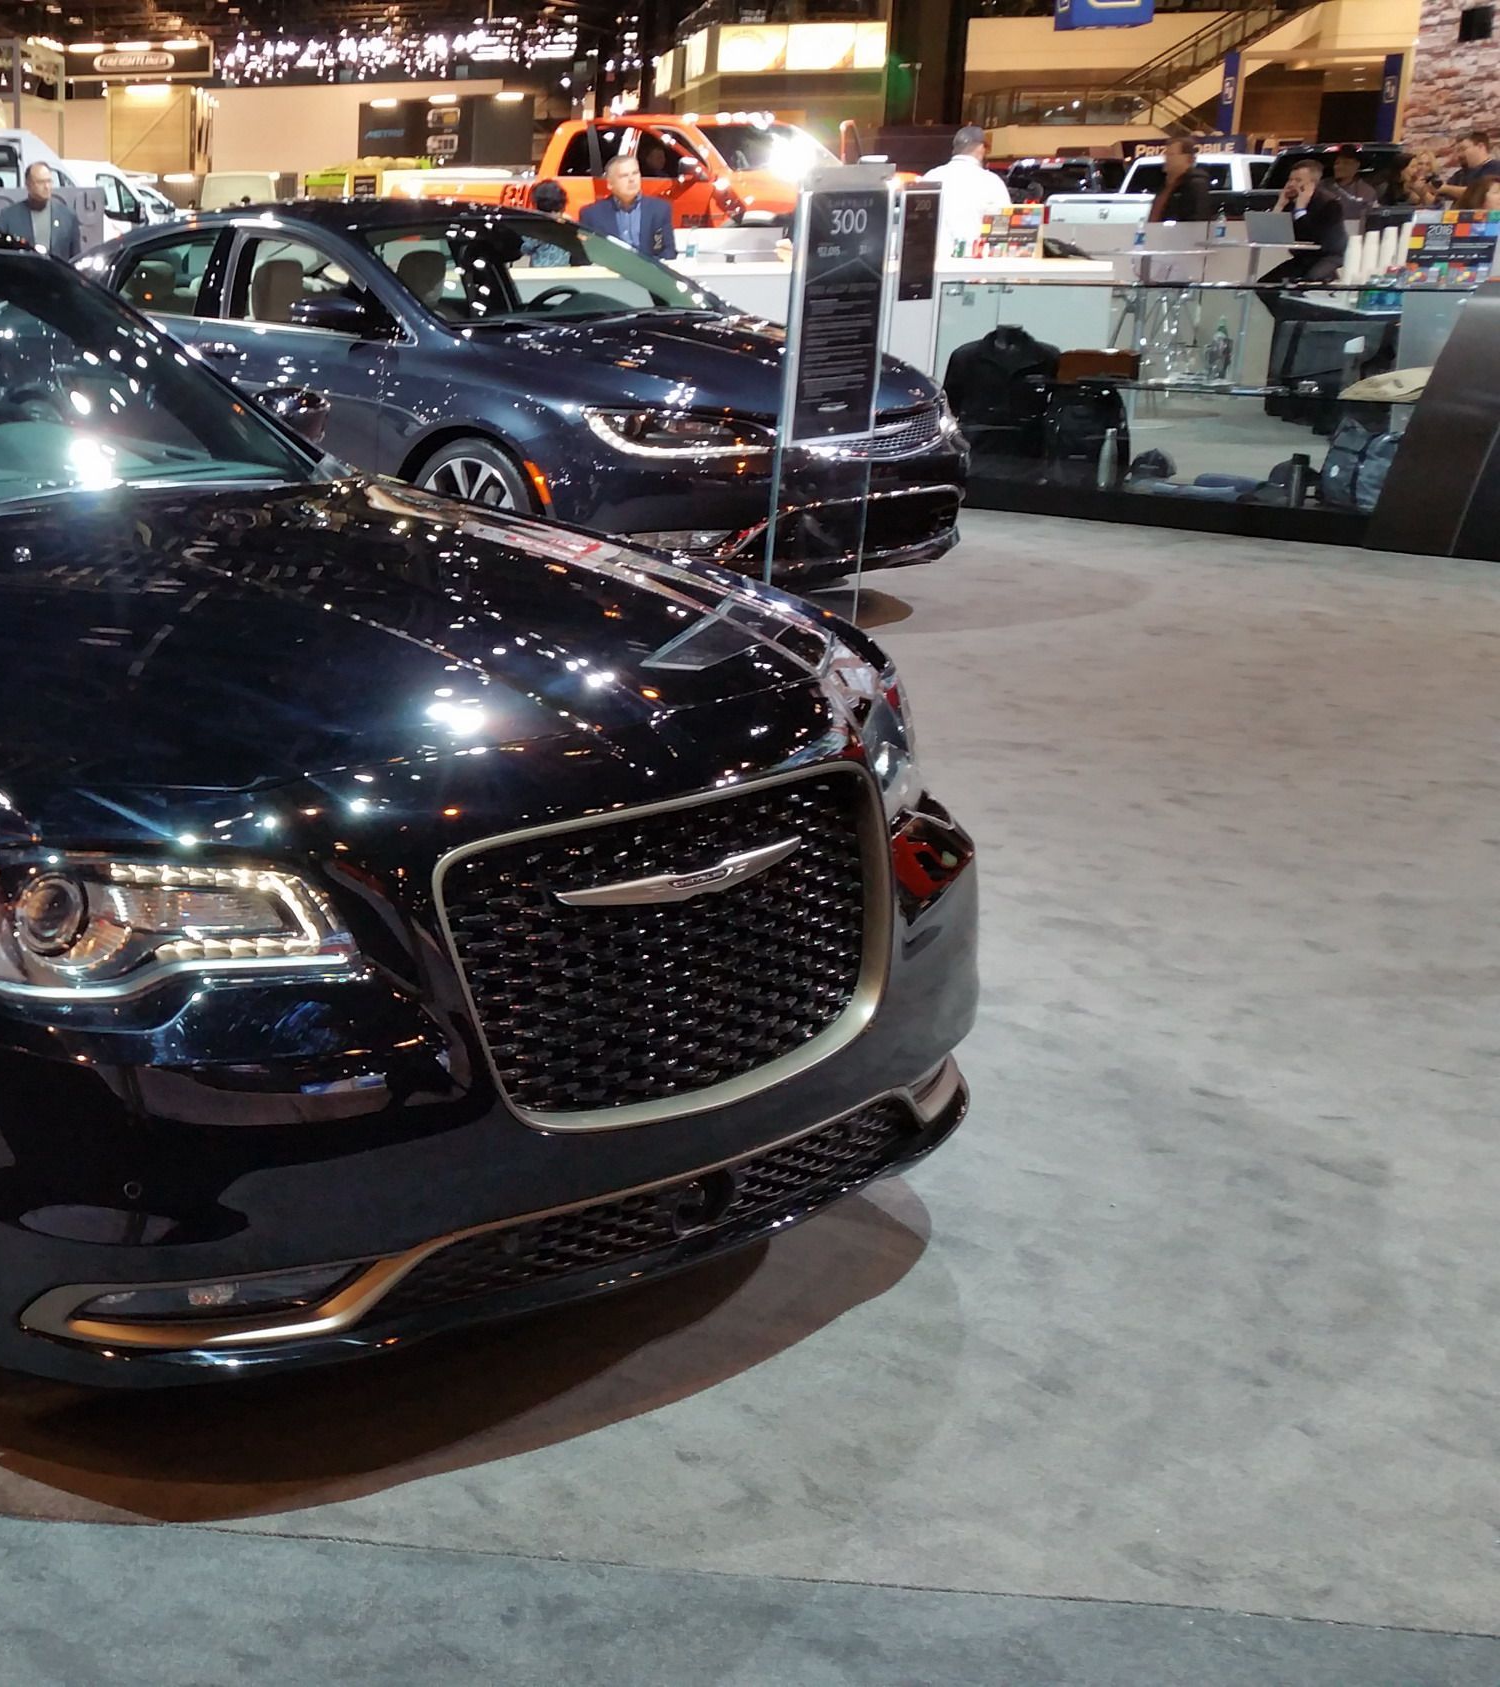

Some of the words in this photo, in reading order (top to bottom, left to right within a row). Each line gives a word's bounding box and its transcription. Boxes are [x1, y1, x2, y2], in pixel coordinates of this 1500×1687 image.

[101, 55, 167, 66] FREIGHTLINER
[1135, 144, 1167, 157] PRIZ
[1192, 142, 1236, 154] OBILE
[830, 208, 868, 235] 300
[1427, 224, 1454, 236] 2016
[672, 870, 725, 888] CHRYSLER
